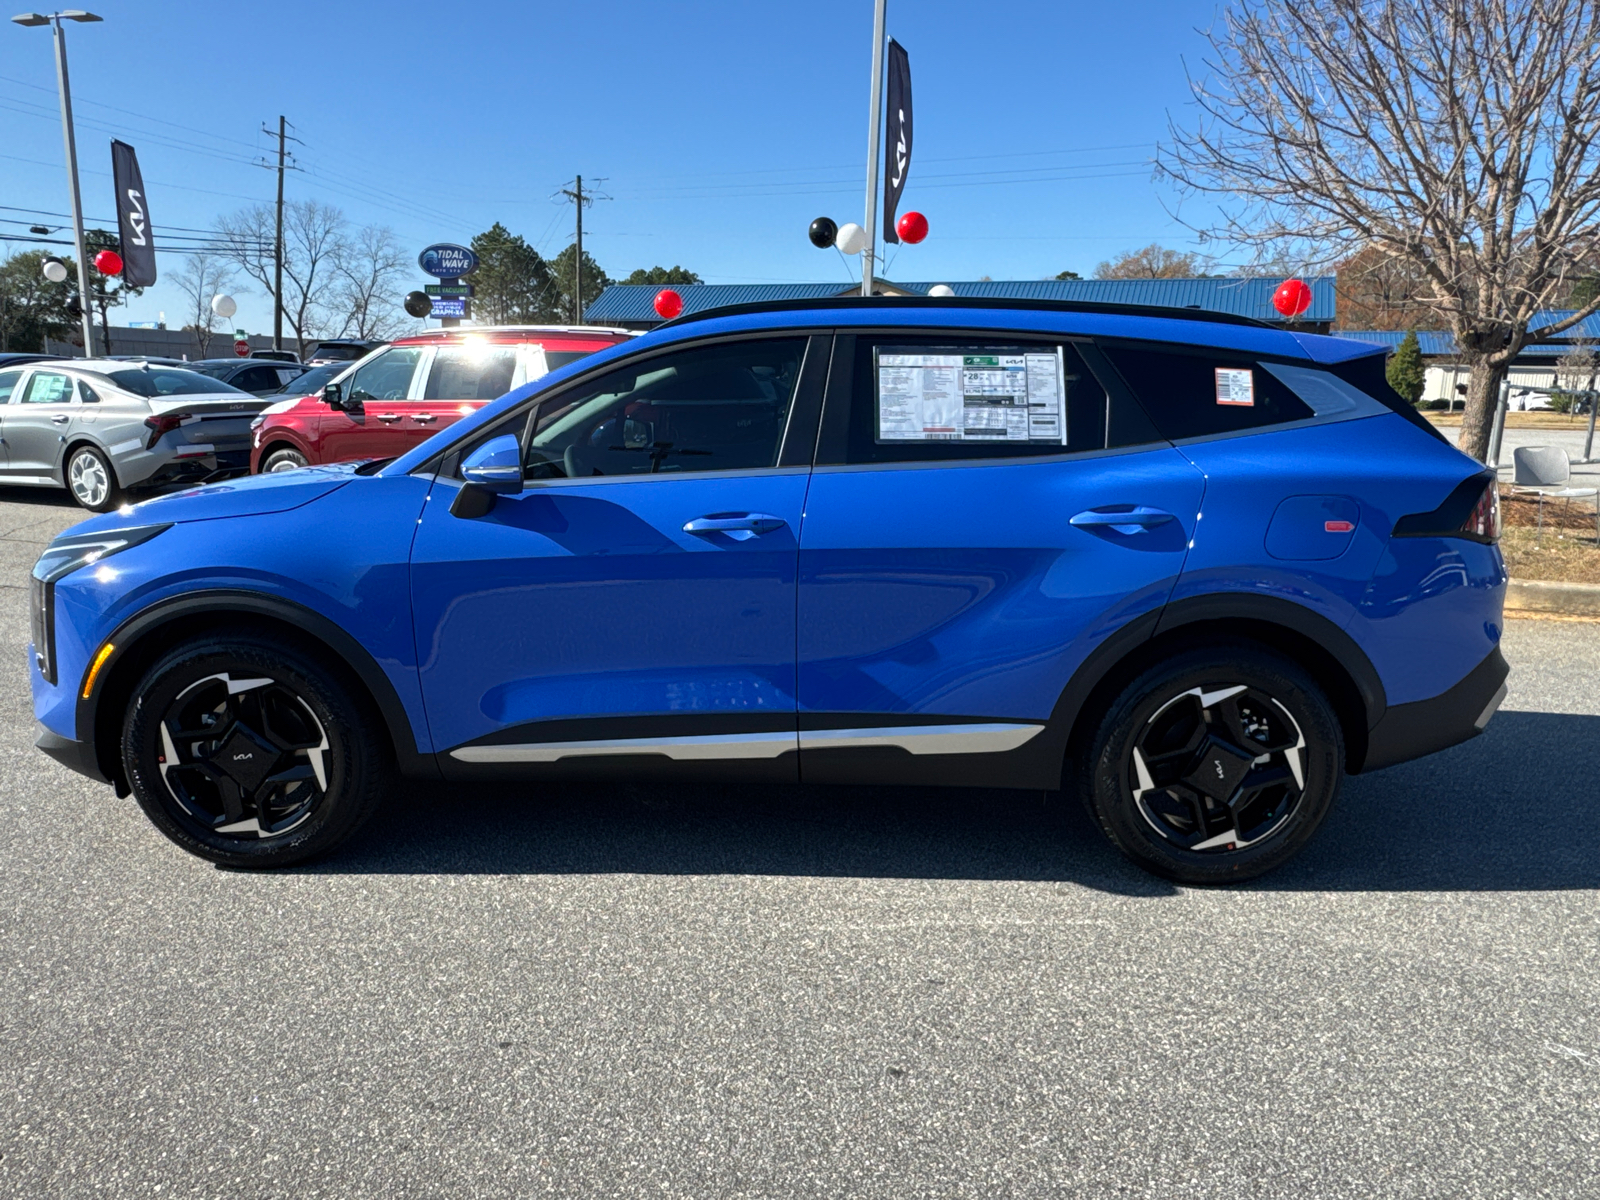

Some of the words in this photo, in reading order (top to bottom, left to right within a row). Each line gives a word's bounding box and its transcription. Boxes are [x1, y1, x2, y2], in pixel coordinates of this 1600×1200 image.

[438, 250, 464, 259] TIDAL
[442, 259, 469, 268] WAVE
[426, 286, 442, 294] FREE
[442, 286, 468, 294] VACUUMS
[967, 372, 979, 380] 28
